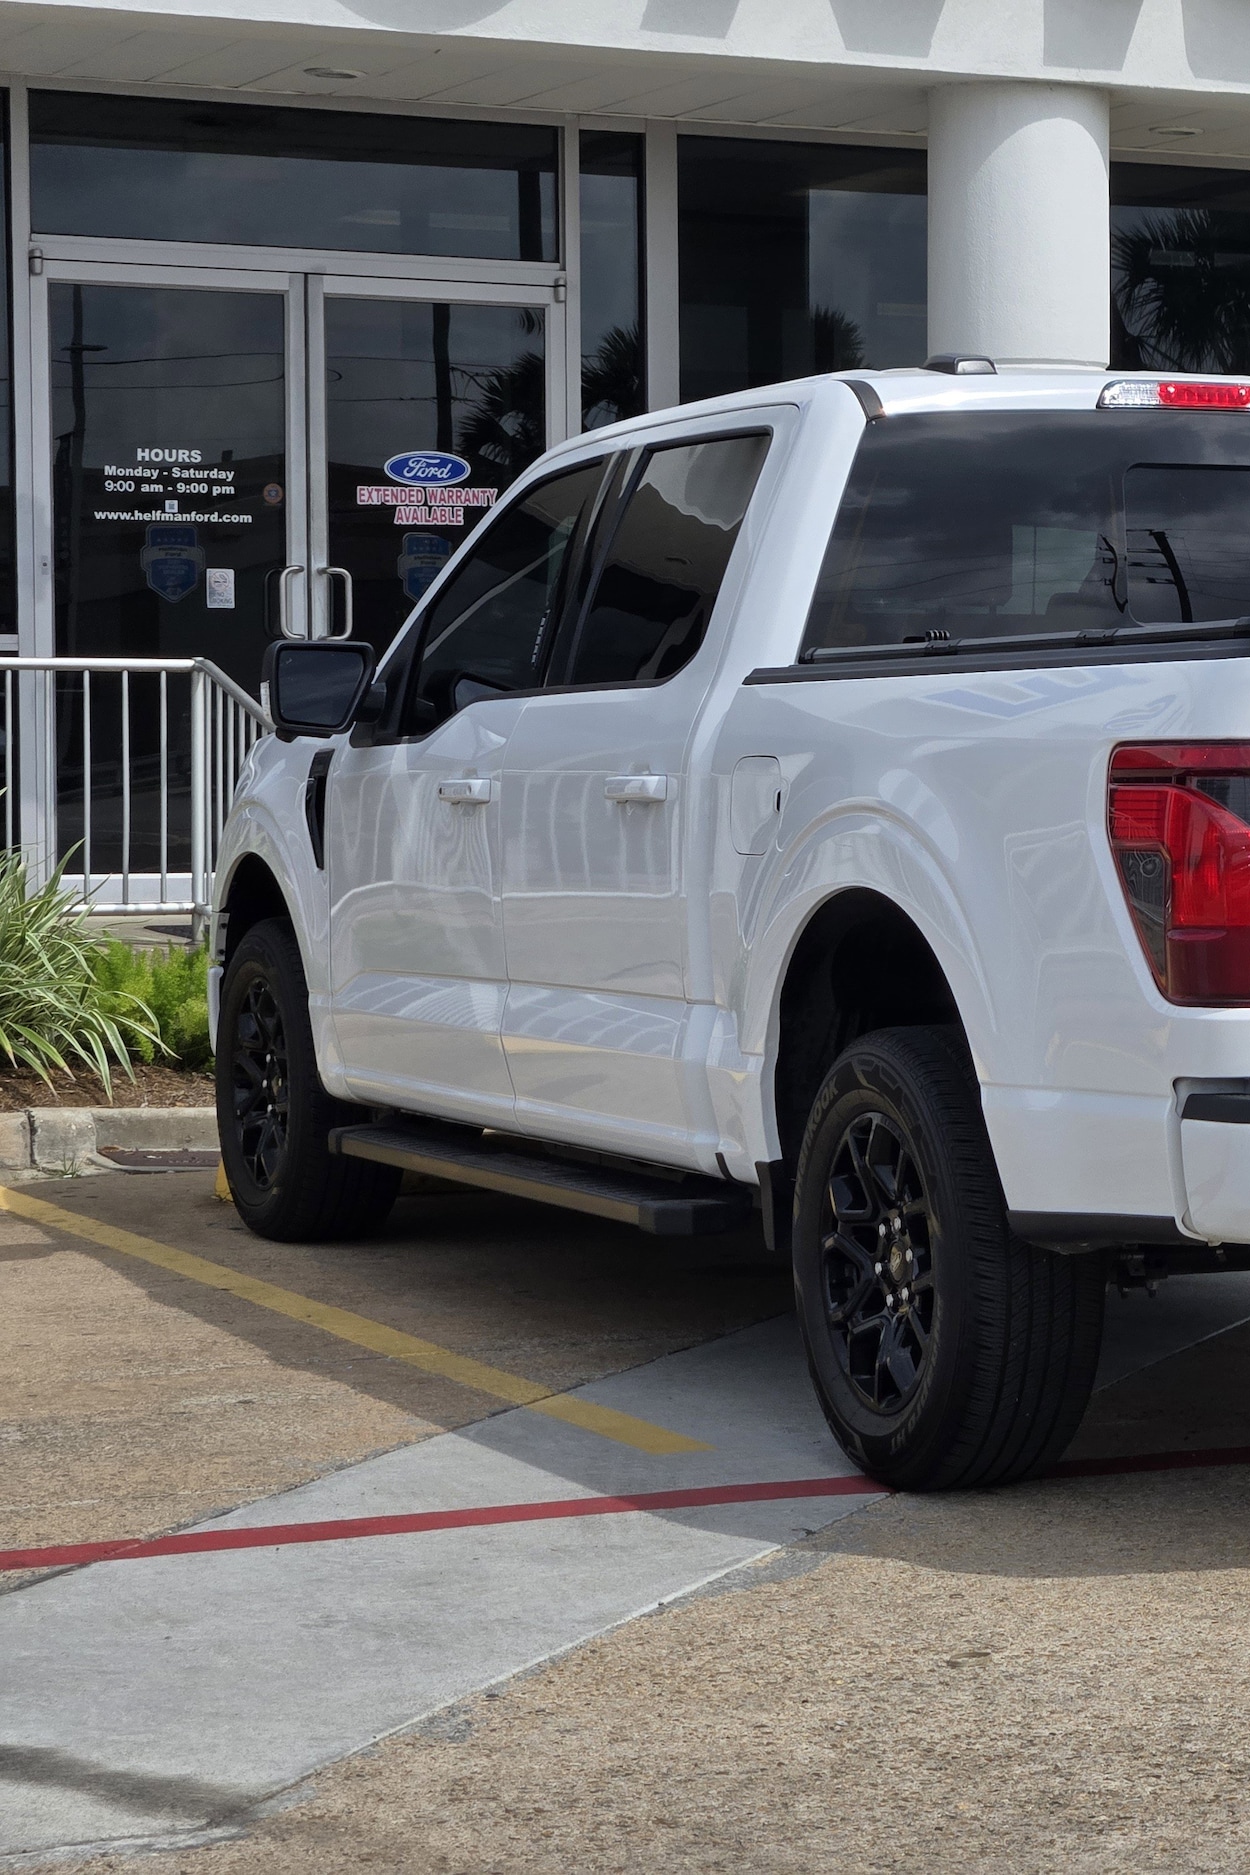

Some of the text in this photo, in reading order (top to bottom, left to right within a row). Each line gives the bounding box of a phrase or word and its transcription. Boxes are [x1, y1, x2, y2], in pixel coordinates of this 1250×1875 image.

[136, 448, 202, 463] HOURS
[104, 465, 159, 479] Monday
[171, 466, 235, 481] Saturday
[403, 457, 453, 479] Ford
[104, 481, 135, 492] 9:00
[141, 484, 163, 493] am
[177, 483, 208, 494] 9:00
[212, 485, 235, 496] pm
[358, 487, 497, 506] EXTENDED WARRANTY
[94, 510, 252, 523] www.helfmanford.com
[394, 507, 464, 525] AVAILABLE
